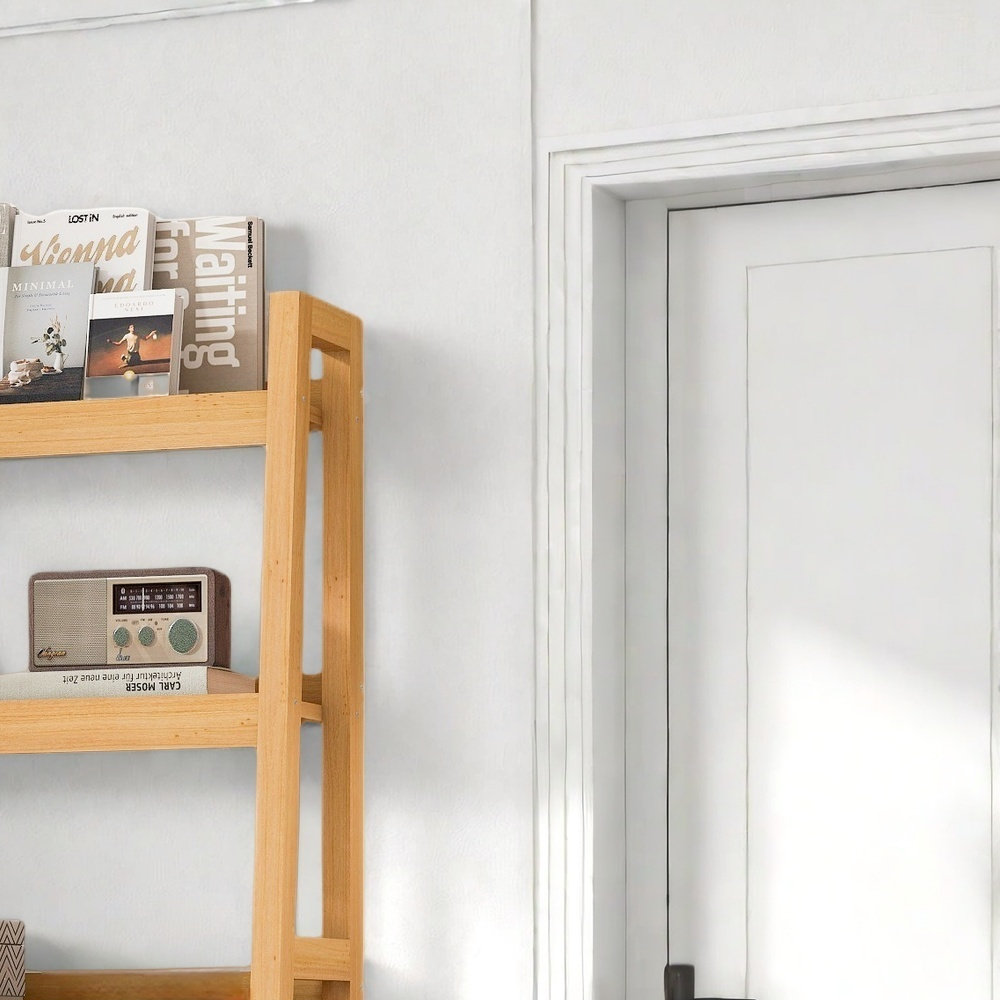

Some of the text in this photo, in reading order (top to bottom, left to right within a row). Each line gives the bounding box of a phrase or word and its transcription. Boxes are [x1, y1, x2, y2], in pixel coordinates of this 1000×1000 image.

[68, 214, 87, 224] LOST
[19, 225, 141, 266] Vienna
[12, 279, 74, 292] MINIMAL
[184, 216, 247, 369] Waiting
[62, 671, 182, 684] Architektur für eine neue Zeit
[125, 681, 182, 692] CARL MOSER
